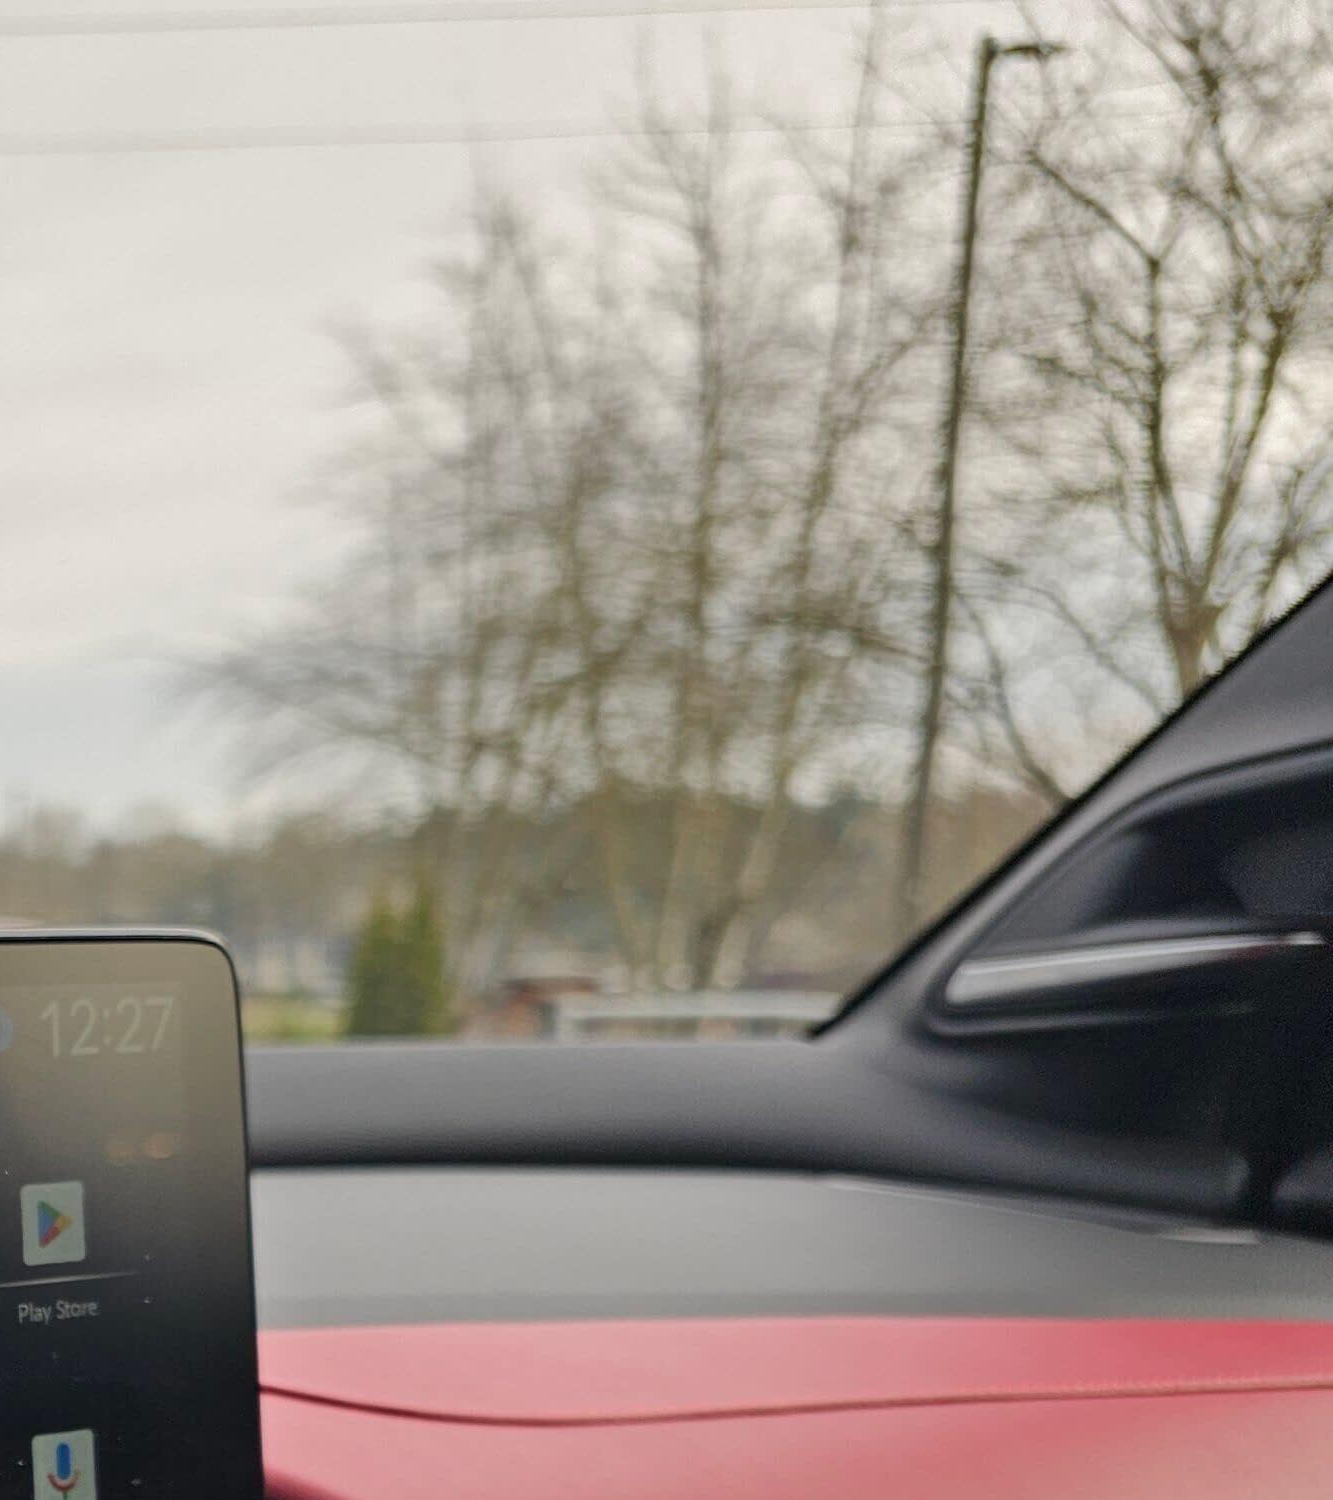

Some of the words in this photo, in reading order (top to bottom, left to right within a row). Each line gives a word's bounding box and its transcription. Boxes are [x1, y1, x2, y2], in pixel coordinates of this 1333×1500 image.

[40, 997, 176, 1057] 12:27
[17, 1302, 52, 1324] Play
[55, 1299, 98, 1320] Store
